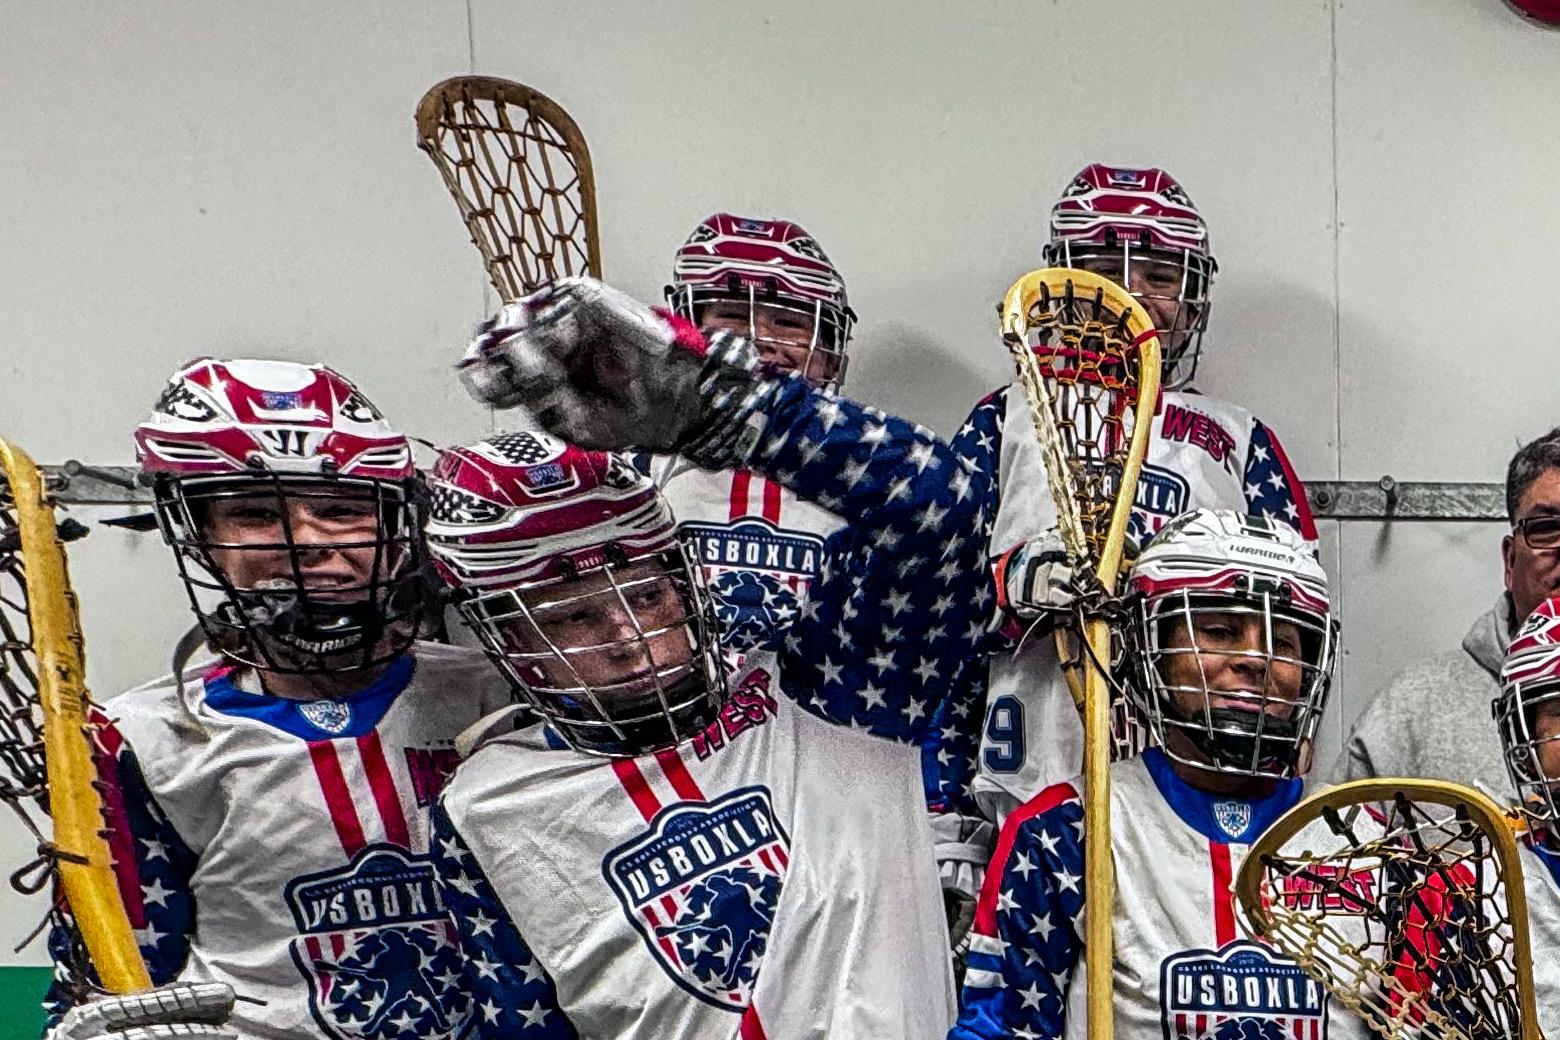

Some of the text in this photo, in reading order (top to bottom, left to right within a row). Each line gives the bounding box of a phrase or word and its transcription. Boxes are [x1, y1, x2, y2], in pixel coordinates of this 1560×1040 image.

[1160, 404, 1236, 475] WEST
[627, 808, 772, 900] USBOXLA
[1177, 974, 1319, 1010] USBOXLA
